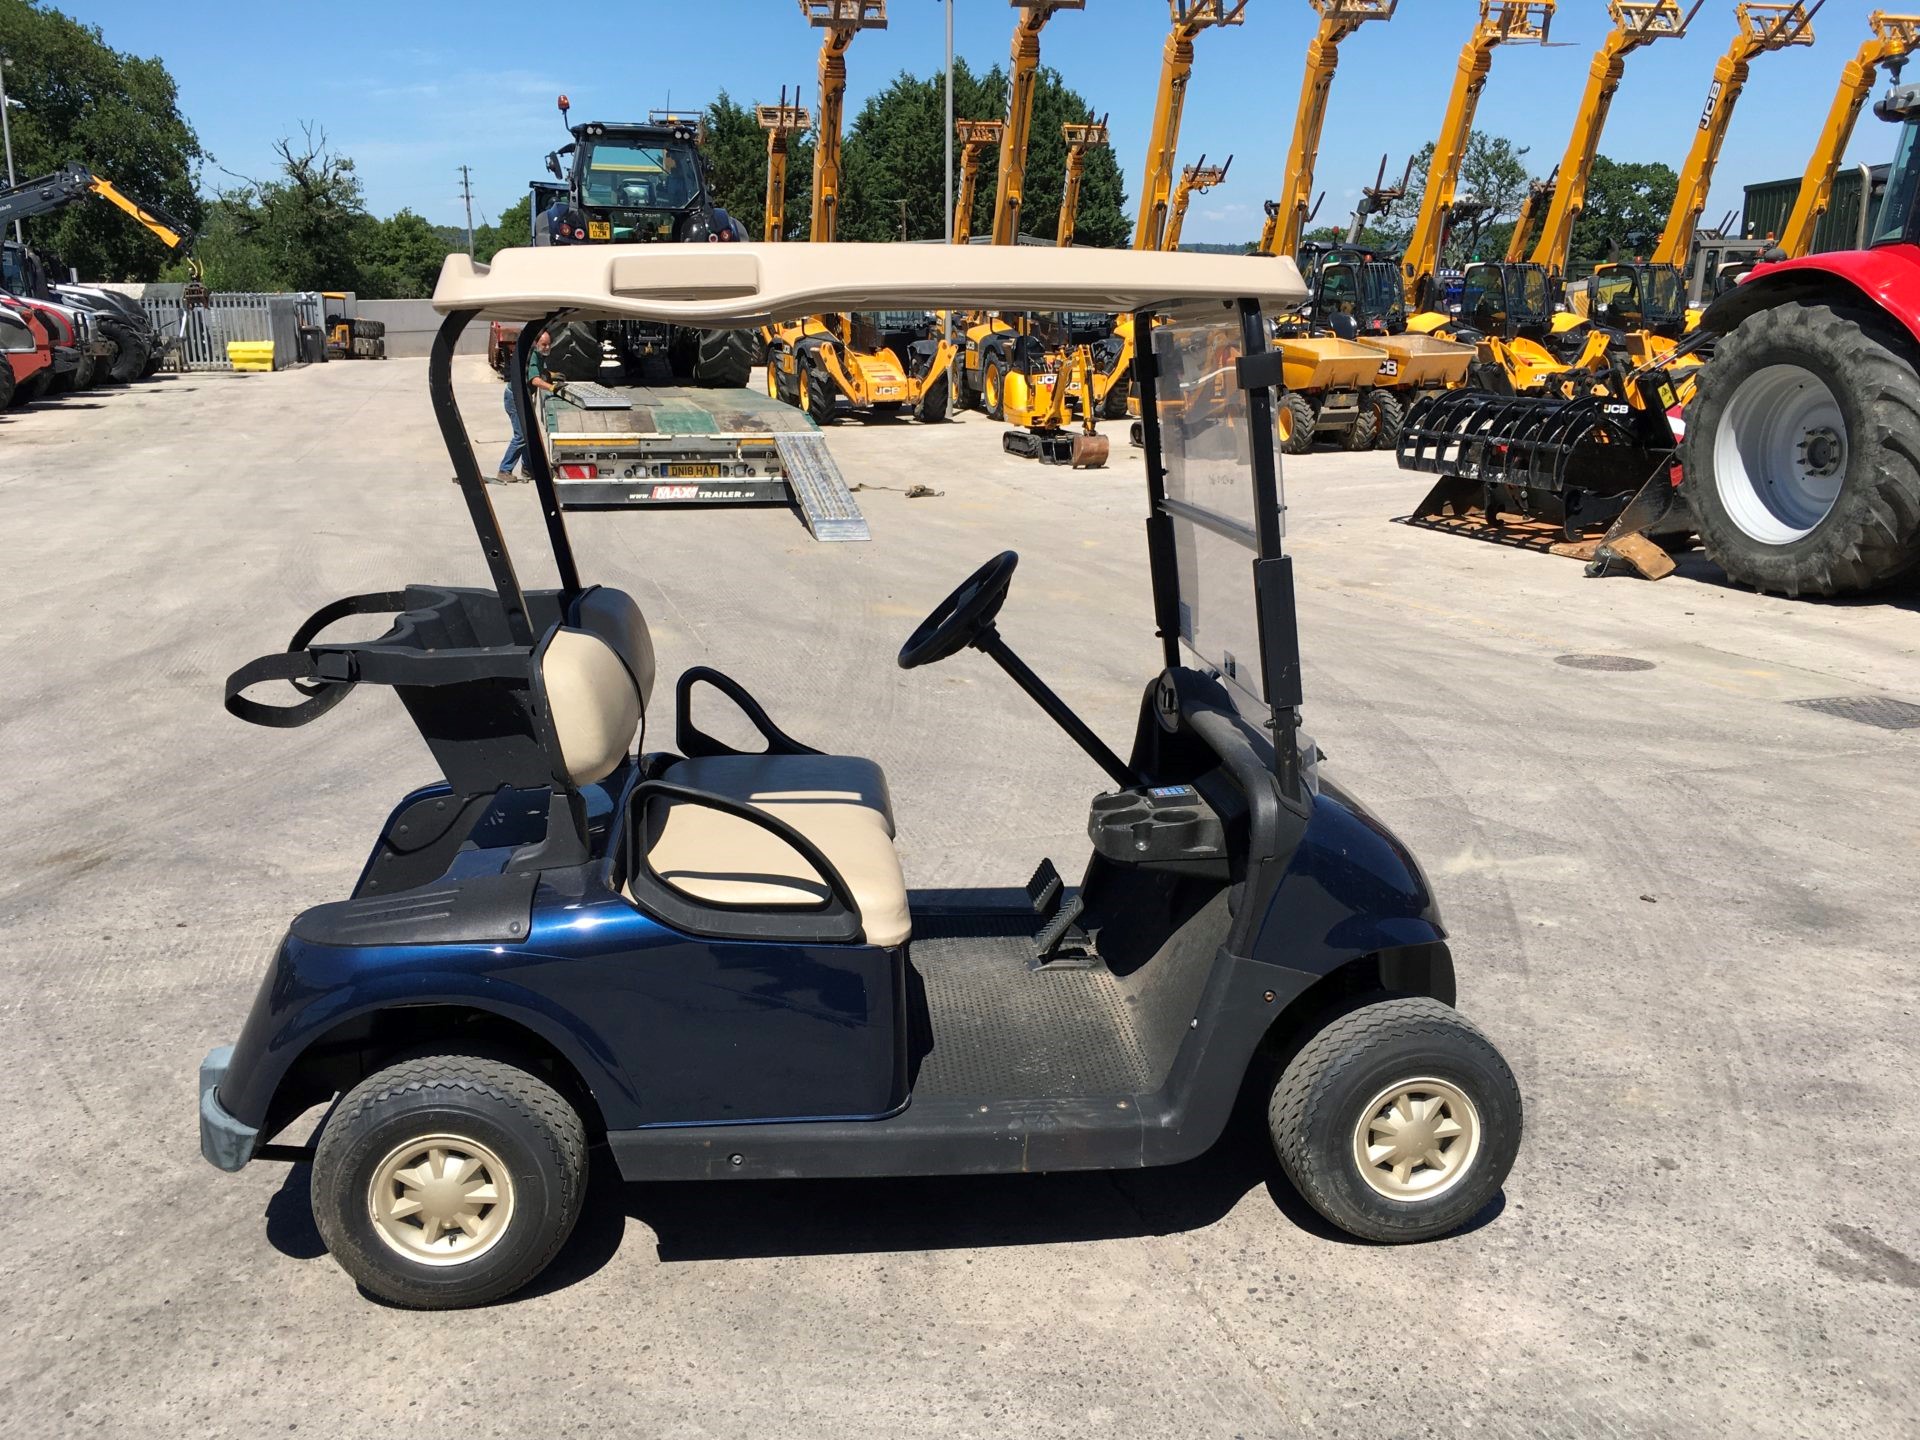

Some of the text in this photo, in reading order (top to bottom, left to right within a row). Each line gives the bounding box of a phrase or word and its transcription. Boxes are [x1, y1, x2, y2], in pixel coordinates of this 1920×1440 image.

[1700, 81, 1721, 130] JCB
[1379, 360, 1397, 375] CB
[1533, 374, 1547, 382] JC
[875, 386, 900, 395] JCB
[1603, 404, 1628, 413] JCB
[671, 464, 715, 476] DN18 HAY
